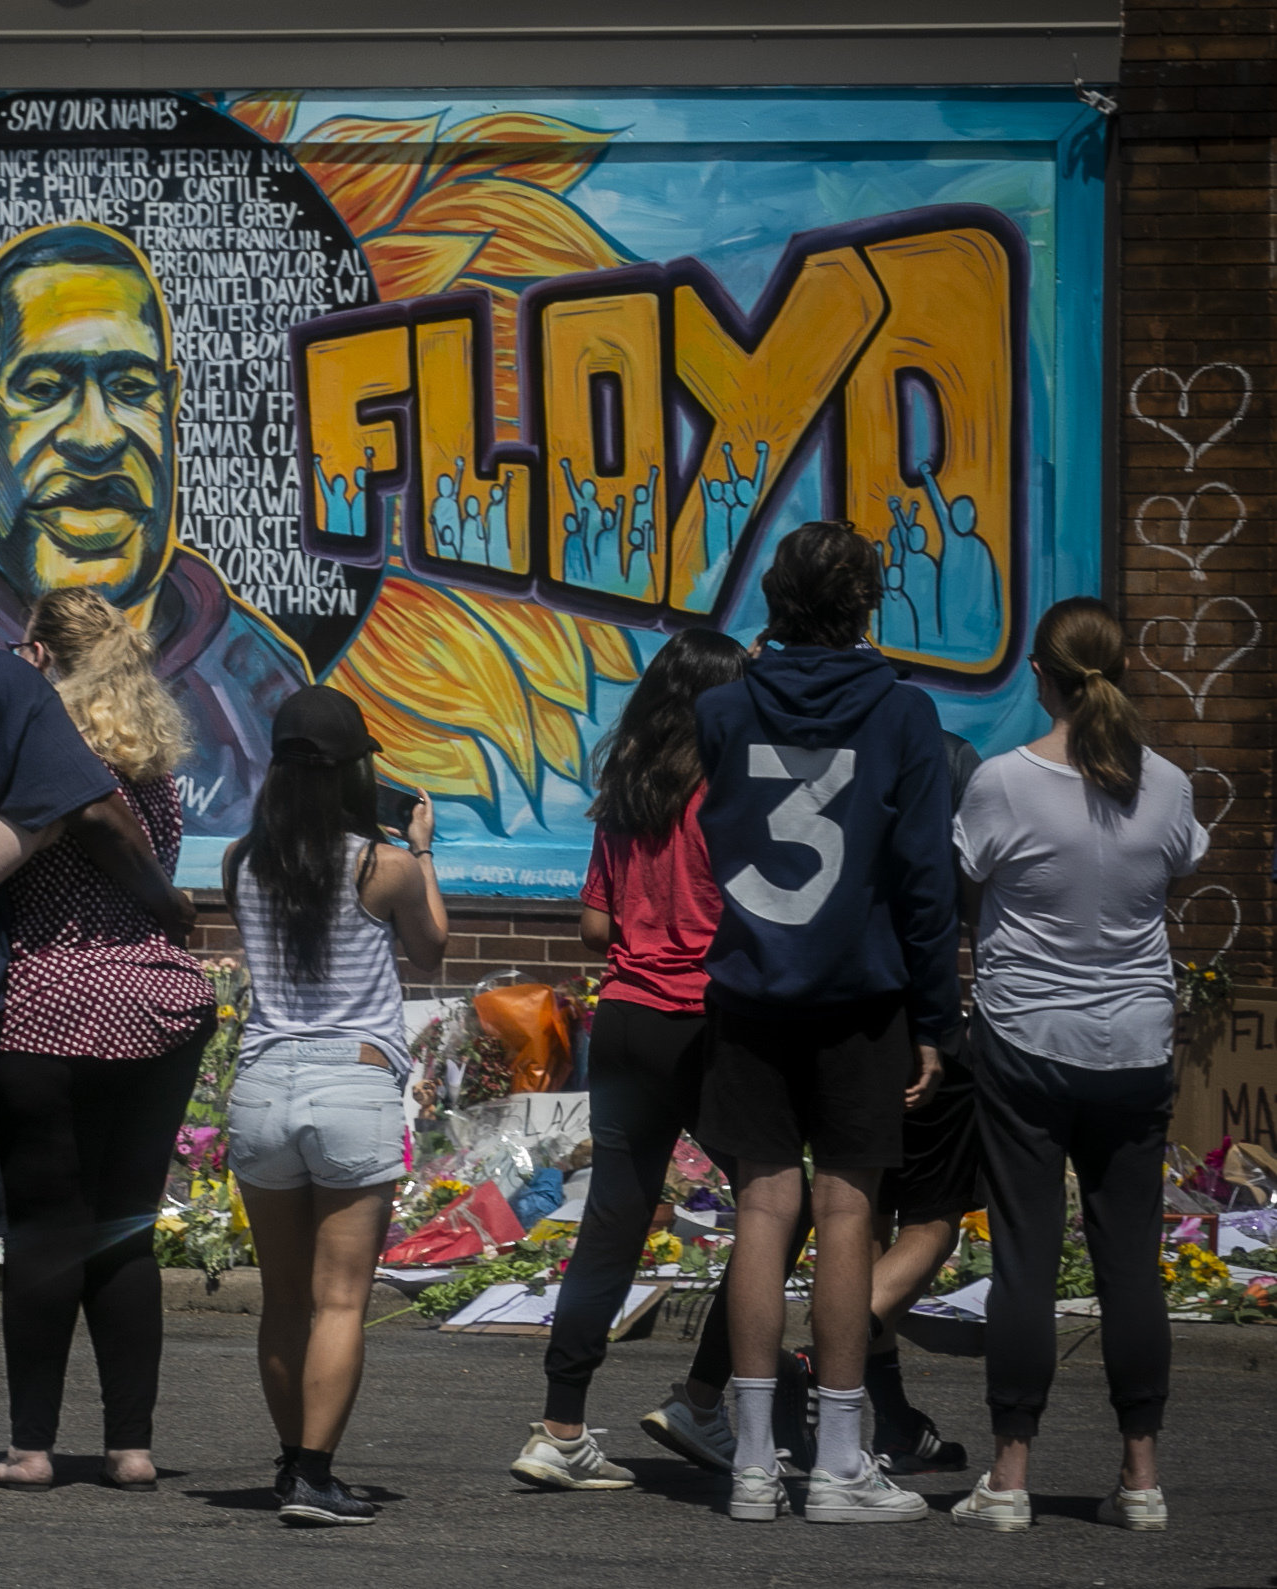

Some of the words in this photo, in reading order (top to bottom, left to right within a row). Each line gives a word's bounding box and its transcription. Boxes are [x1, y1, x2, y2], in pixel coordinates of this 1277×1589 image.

[7, 100, 57, 131] SAY
[59, 98, 109, 131] OUR
[111, 98, 179, 131] NAMES
[44, 148, 151, 178] CRUTCHER
[156, 149, 253, 179] JEREMY
[43, 176, 164, 201] PHILANDO
[183, 176, 272, 204] CASTILE
[57, 200, 129, 226] JAMES
[144, 202, 234, 229] FREDDIE
[238, 202, 298, 230] GREY
[131, 225, 222, 251] TERRANCE
[225, 228, 321, 251] FRANKLIN
[150, 251, 248, 278] BREONNA
[247, 250, 329, 278] TAYLOR
[336, 249, 367, 276] AL
[162, 276, 259, 304] SHANTEL
[261, 278, 327, 304] DAVIS
[168, 304, 258, 332] WALTER
[173, 332, 237, 361] REKIA
[179, 389, 261, 422] SHELLY
[175, 422, 258, 457] JAMAR
[302, 222, 1017, 676] FLOYD
[178, 456, 277, 488] TANISHA
[178, 486, 263, 517] TARIKA
[179, 515, 254, 550] ALTON
[256, 515, 300, 550] STE
[239, 584, 357, 617] KATHRYN
[724, 743, 857, 926] 3
[1230, 1009, 1277, 1053] FL
[1222, 1081, 1277, 1146] MA
